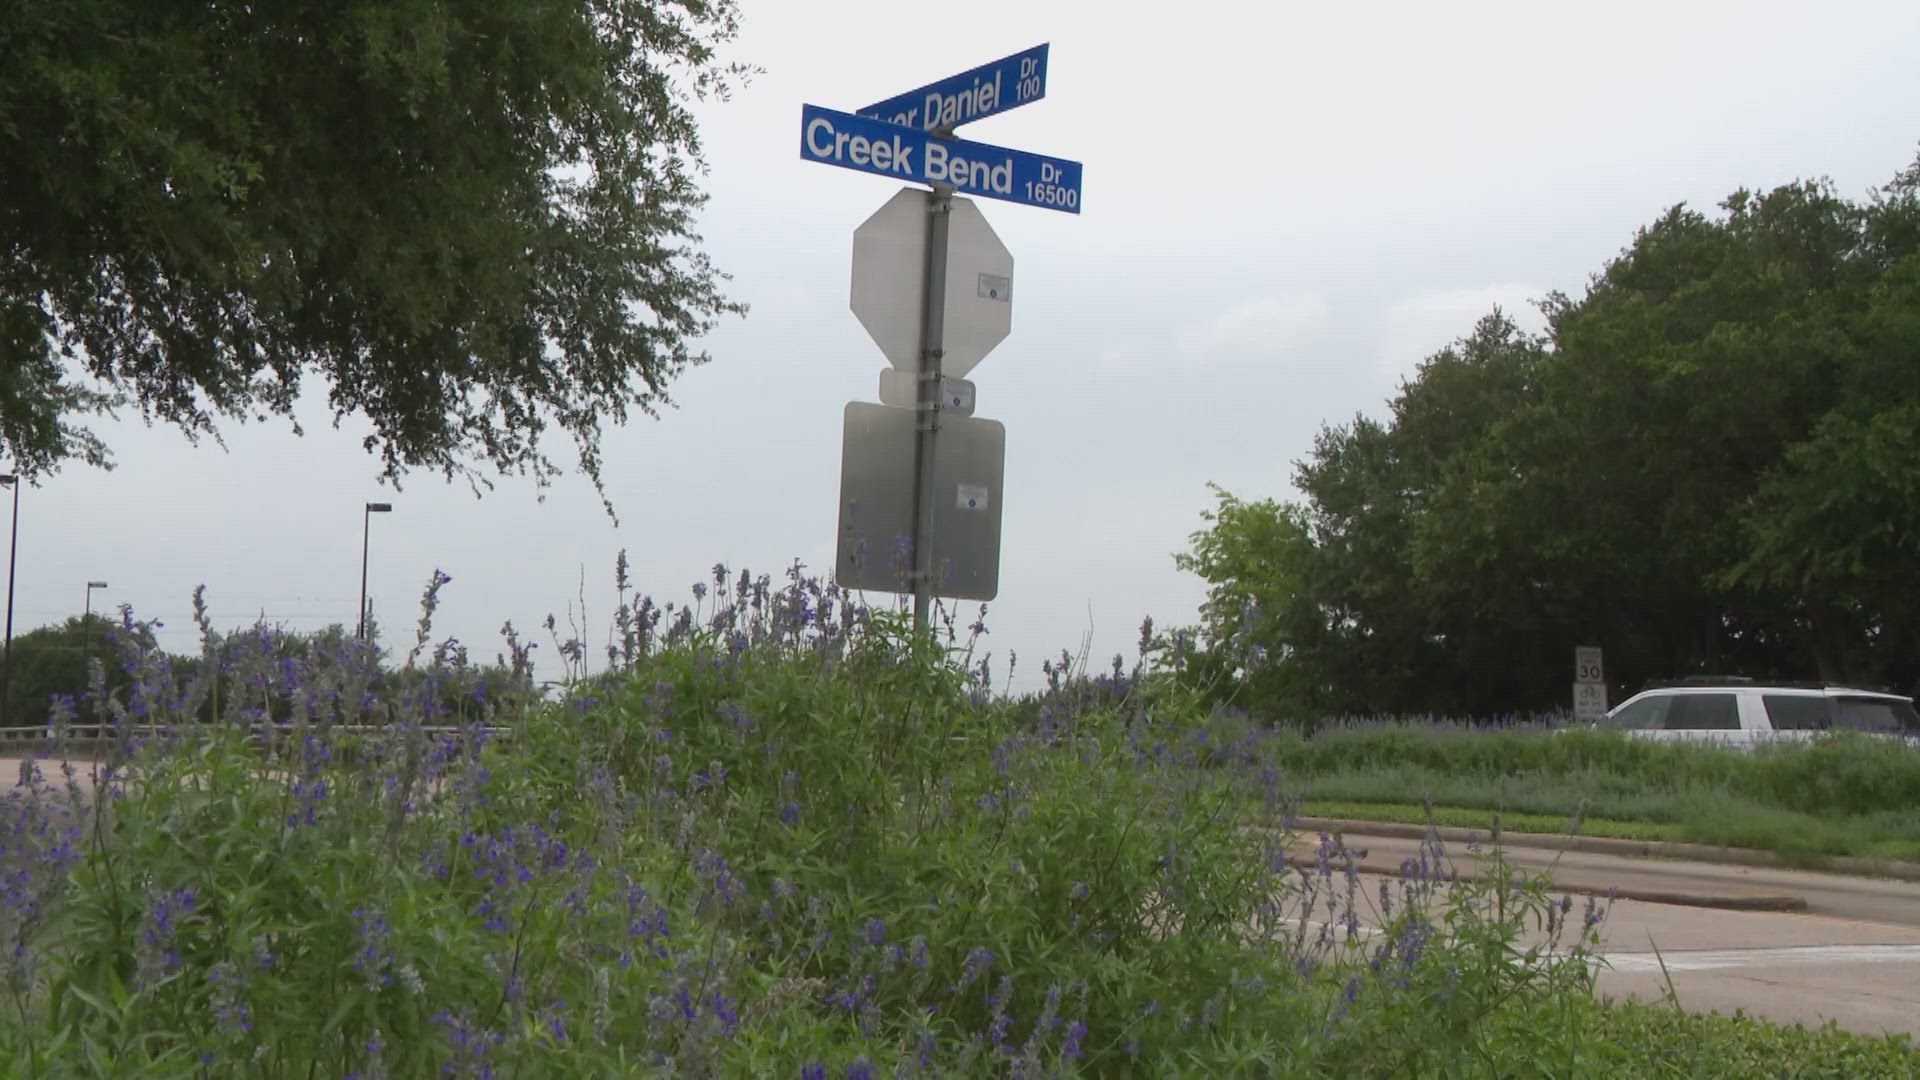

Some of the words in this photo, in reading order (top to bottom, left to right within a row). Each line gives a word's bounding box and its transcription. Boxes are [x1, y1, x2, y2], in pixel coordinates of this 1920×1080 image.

[1020, 56, 1038, 79] Dr
[923, 70, 1002, 131] Daniel
[1016, 77, 1040, 101] 100
[806, 117, 912, 175] Creek
[924, 141, 1013, 194] Bend
[1041, 162, 1062, 184] Dr
[1025, 181, 1077, 208] 16500
[1580, 665, 1600, 678] 30
